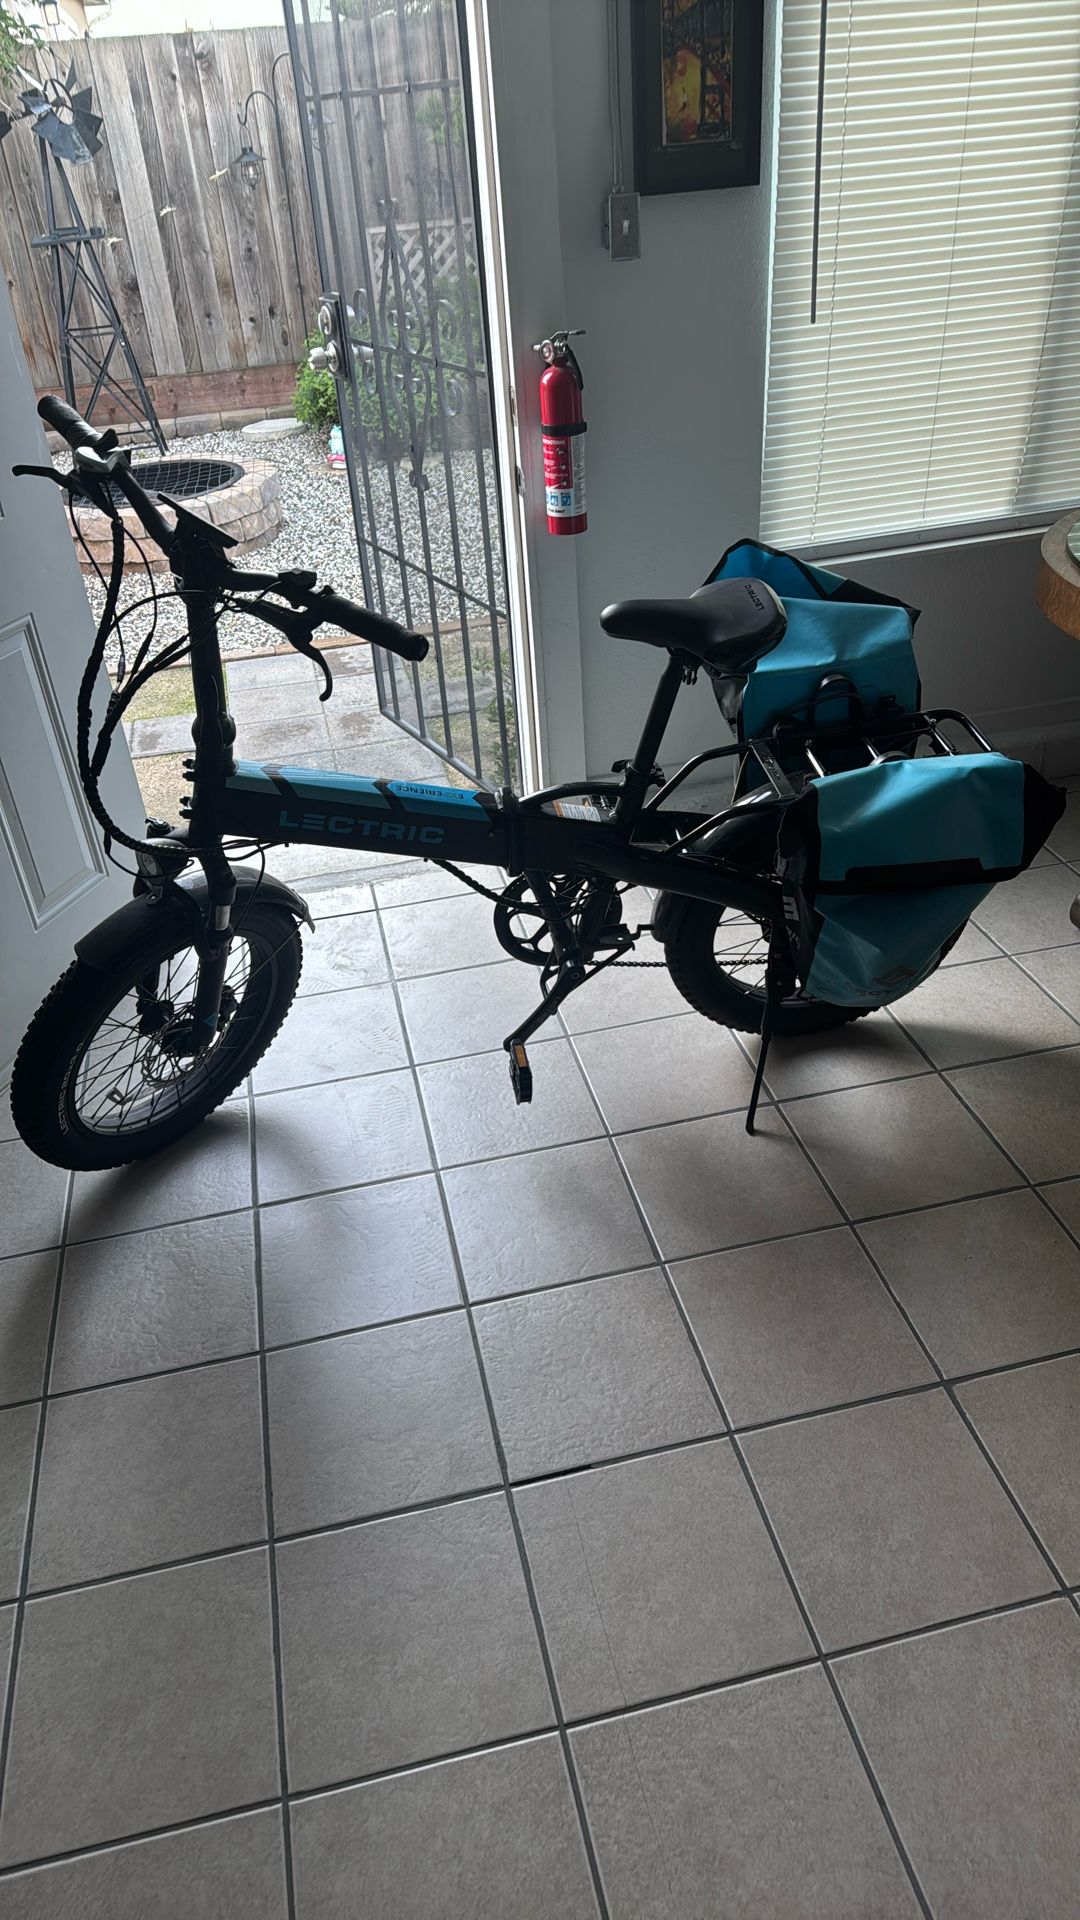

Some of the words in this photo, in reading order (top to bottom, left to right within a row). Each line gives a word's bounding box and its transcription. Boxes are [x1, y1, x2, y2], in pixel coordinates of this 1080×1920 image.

[744, 585, 765, 611] LECTRIC
[396, 785, 464, 800] EERIENCE
[279, 809, 446, 845] LECTRIC
[58, 1089, 69, 1136] LECTRIC
